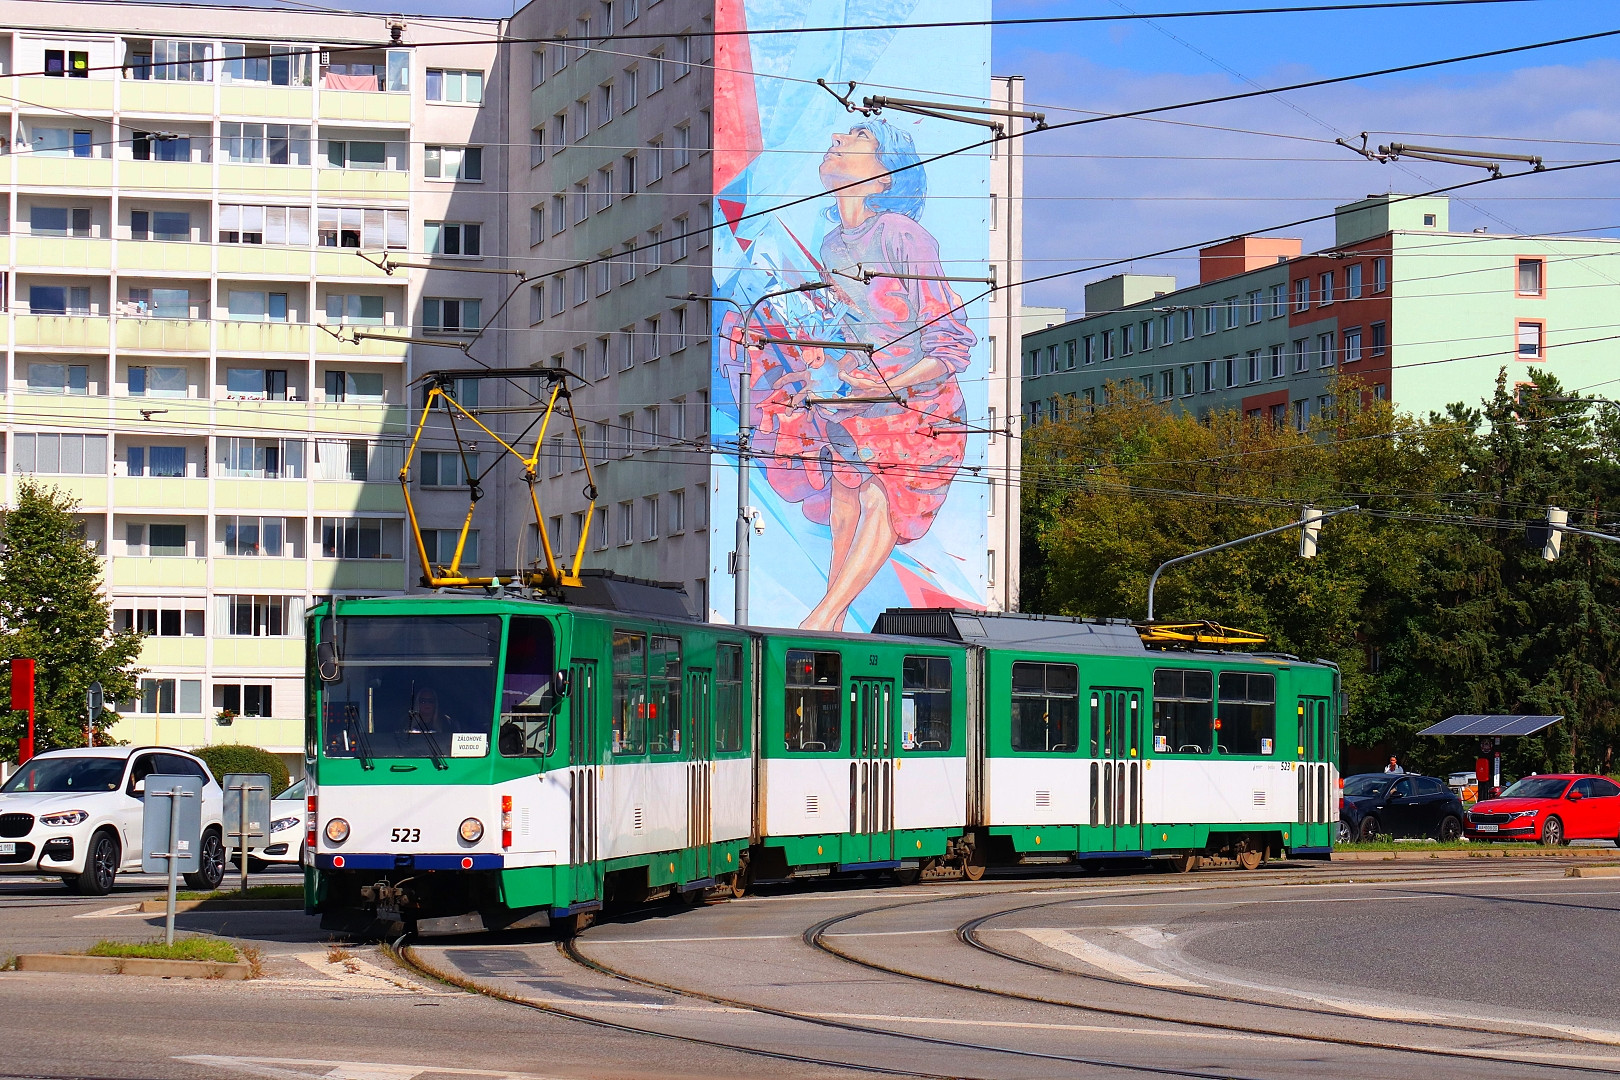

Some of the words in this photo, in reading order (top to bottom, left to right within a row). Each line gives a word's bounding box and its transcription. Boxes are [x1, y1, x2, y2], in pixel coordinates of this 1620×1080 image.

[869, 654, 878, 666] 523
[457, 734, 482, 742] ZÁLOHOVÉ
[1280, 761, 1291, 771] 523
[390, 828, 421, 843] 523
